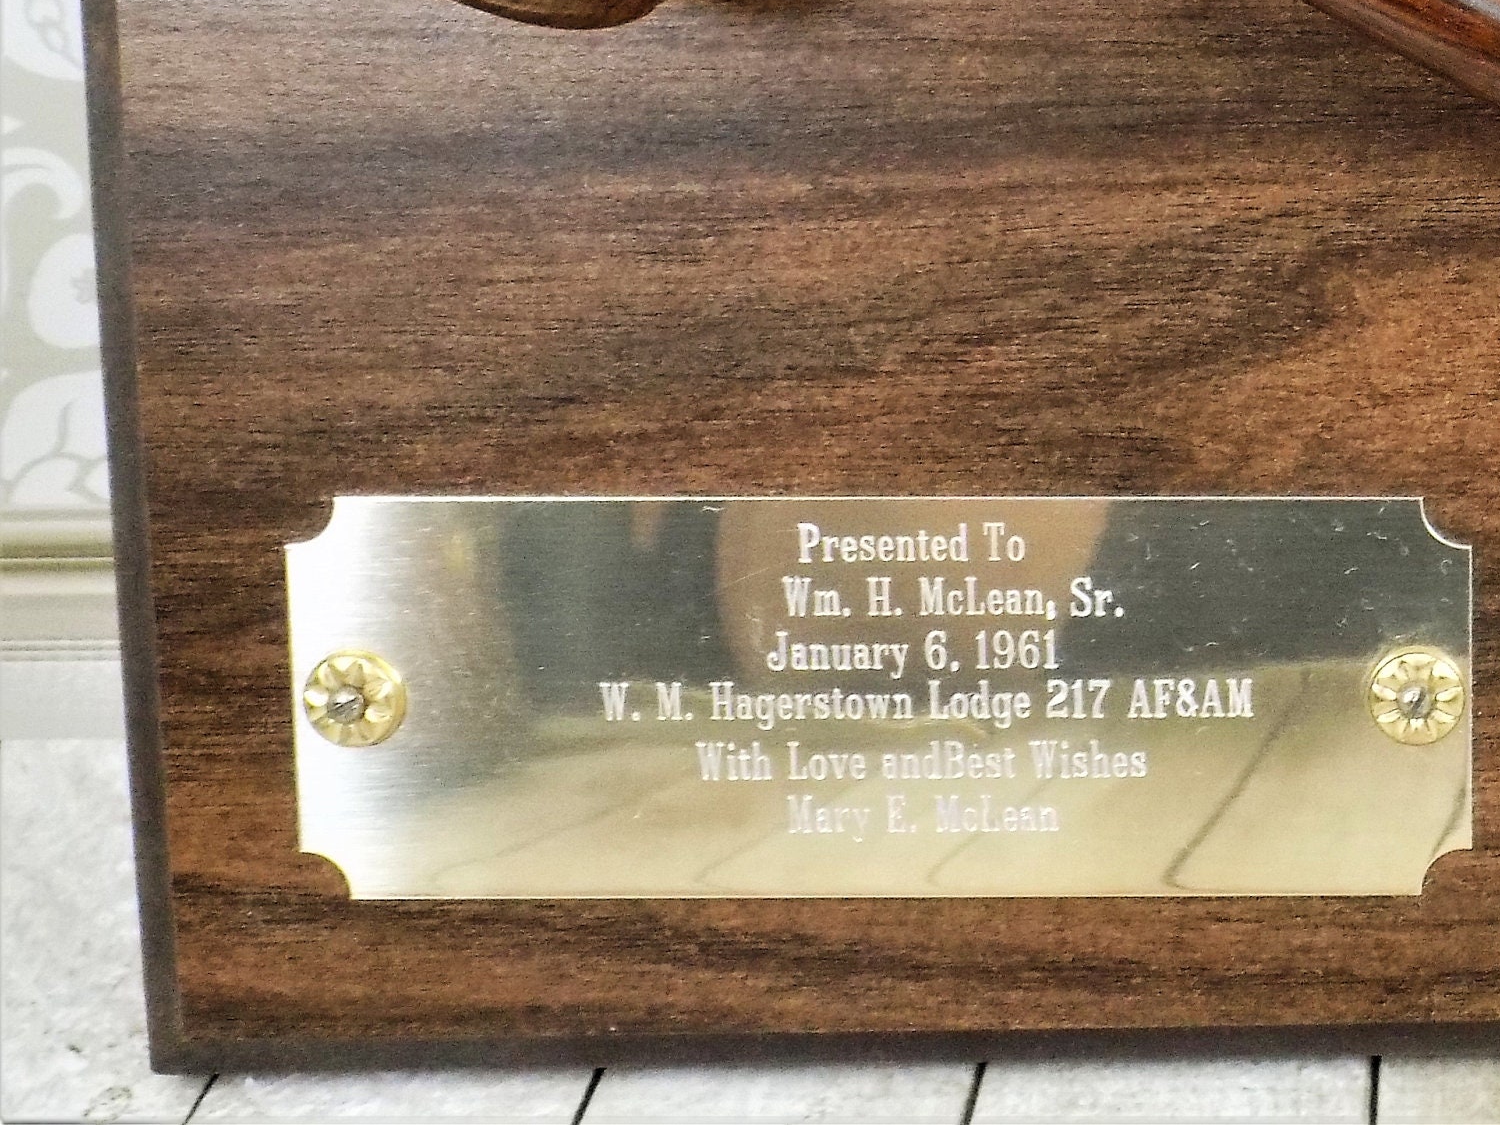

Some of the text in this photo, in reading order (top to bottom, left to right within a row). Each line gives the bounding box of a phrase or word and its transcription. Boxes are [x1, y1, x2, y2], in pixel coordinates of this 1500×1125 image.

[796, 522, 1026, 564] Presented To
[782, 575, 1126, 621] Wm. H. McLean, Sr.
[765, 630, 910, 680] January
[974, 629, 1060, 671] 1961
[598, 677, 1256, 731] W. M. Hagerstown Lodge 217 AF&AM
[694, 740, 773, 781] With
[786, 740, 867, 781] Love
[1027, 739, 1149, 779] Wishes
[785, 793, 1061, 844] Mary E. McLean
